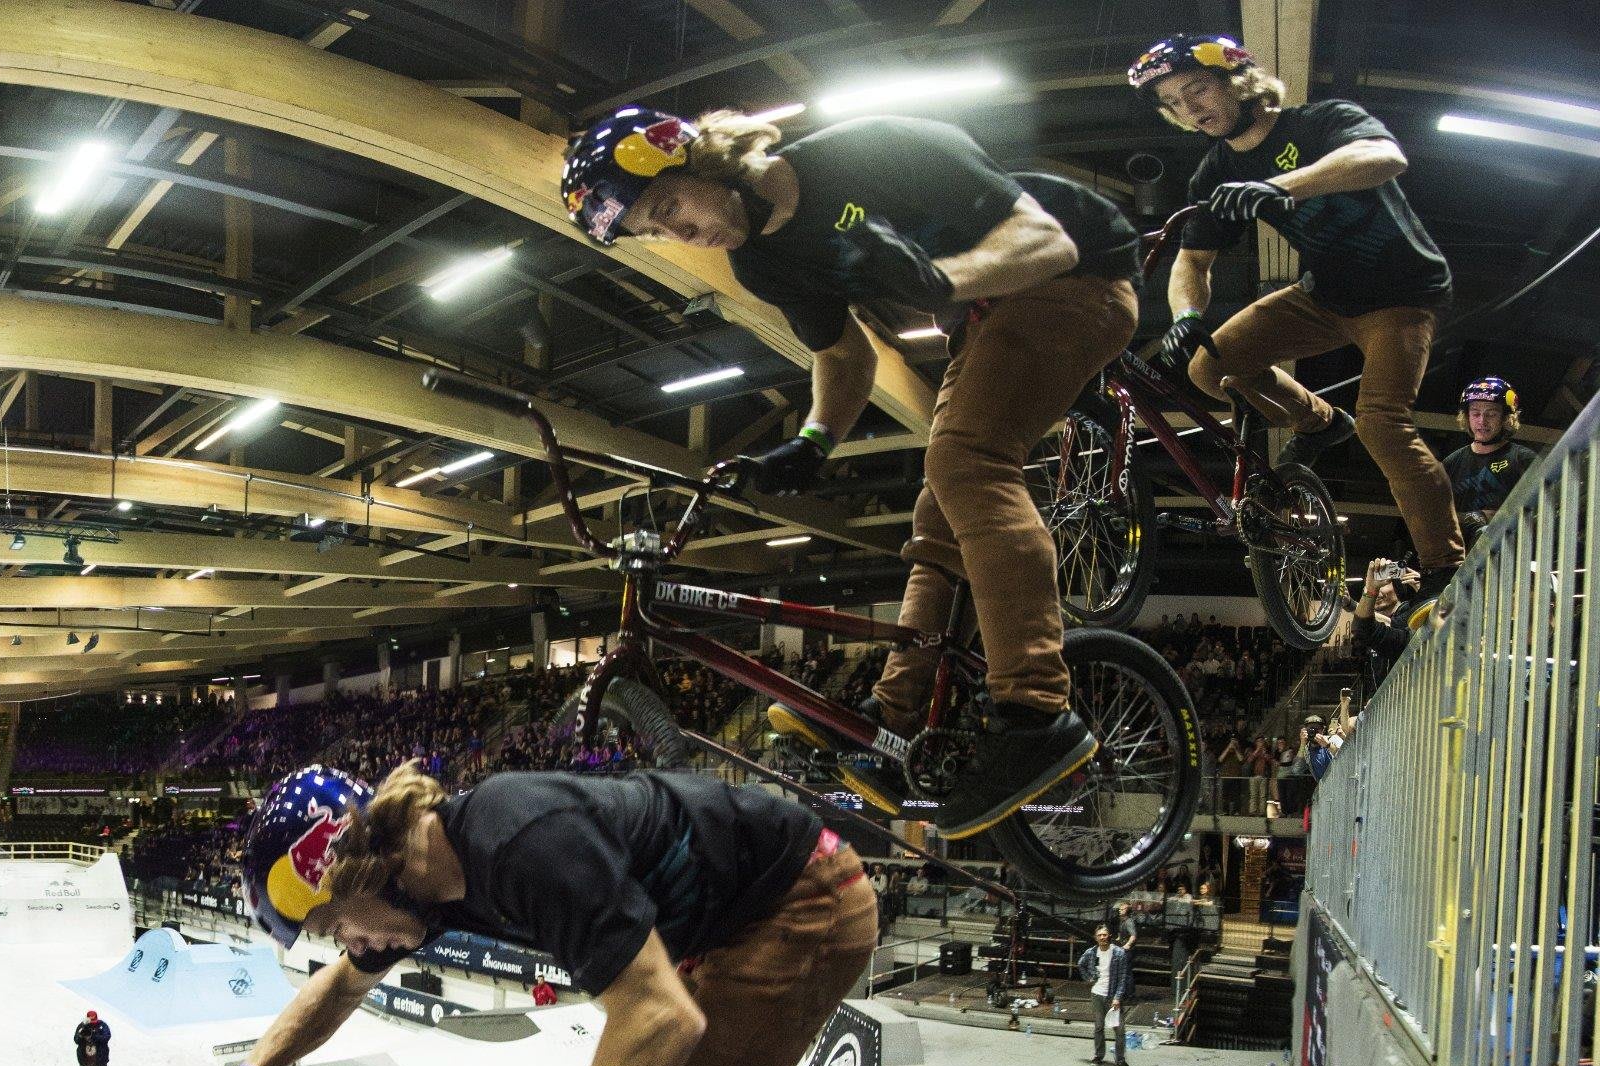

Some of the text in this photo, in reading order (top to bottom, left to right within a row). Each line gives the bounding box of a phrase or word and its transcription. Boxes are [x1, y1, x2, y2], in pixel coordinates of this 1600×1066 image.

[655, 581, 678, 602] DK
[680, 584, 714, 608] BIKE
[434, 945, 470, 960] VAPIANO
[482, 958, 523, 975] KINGIVABRIK
